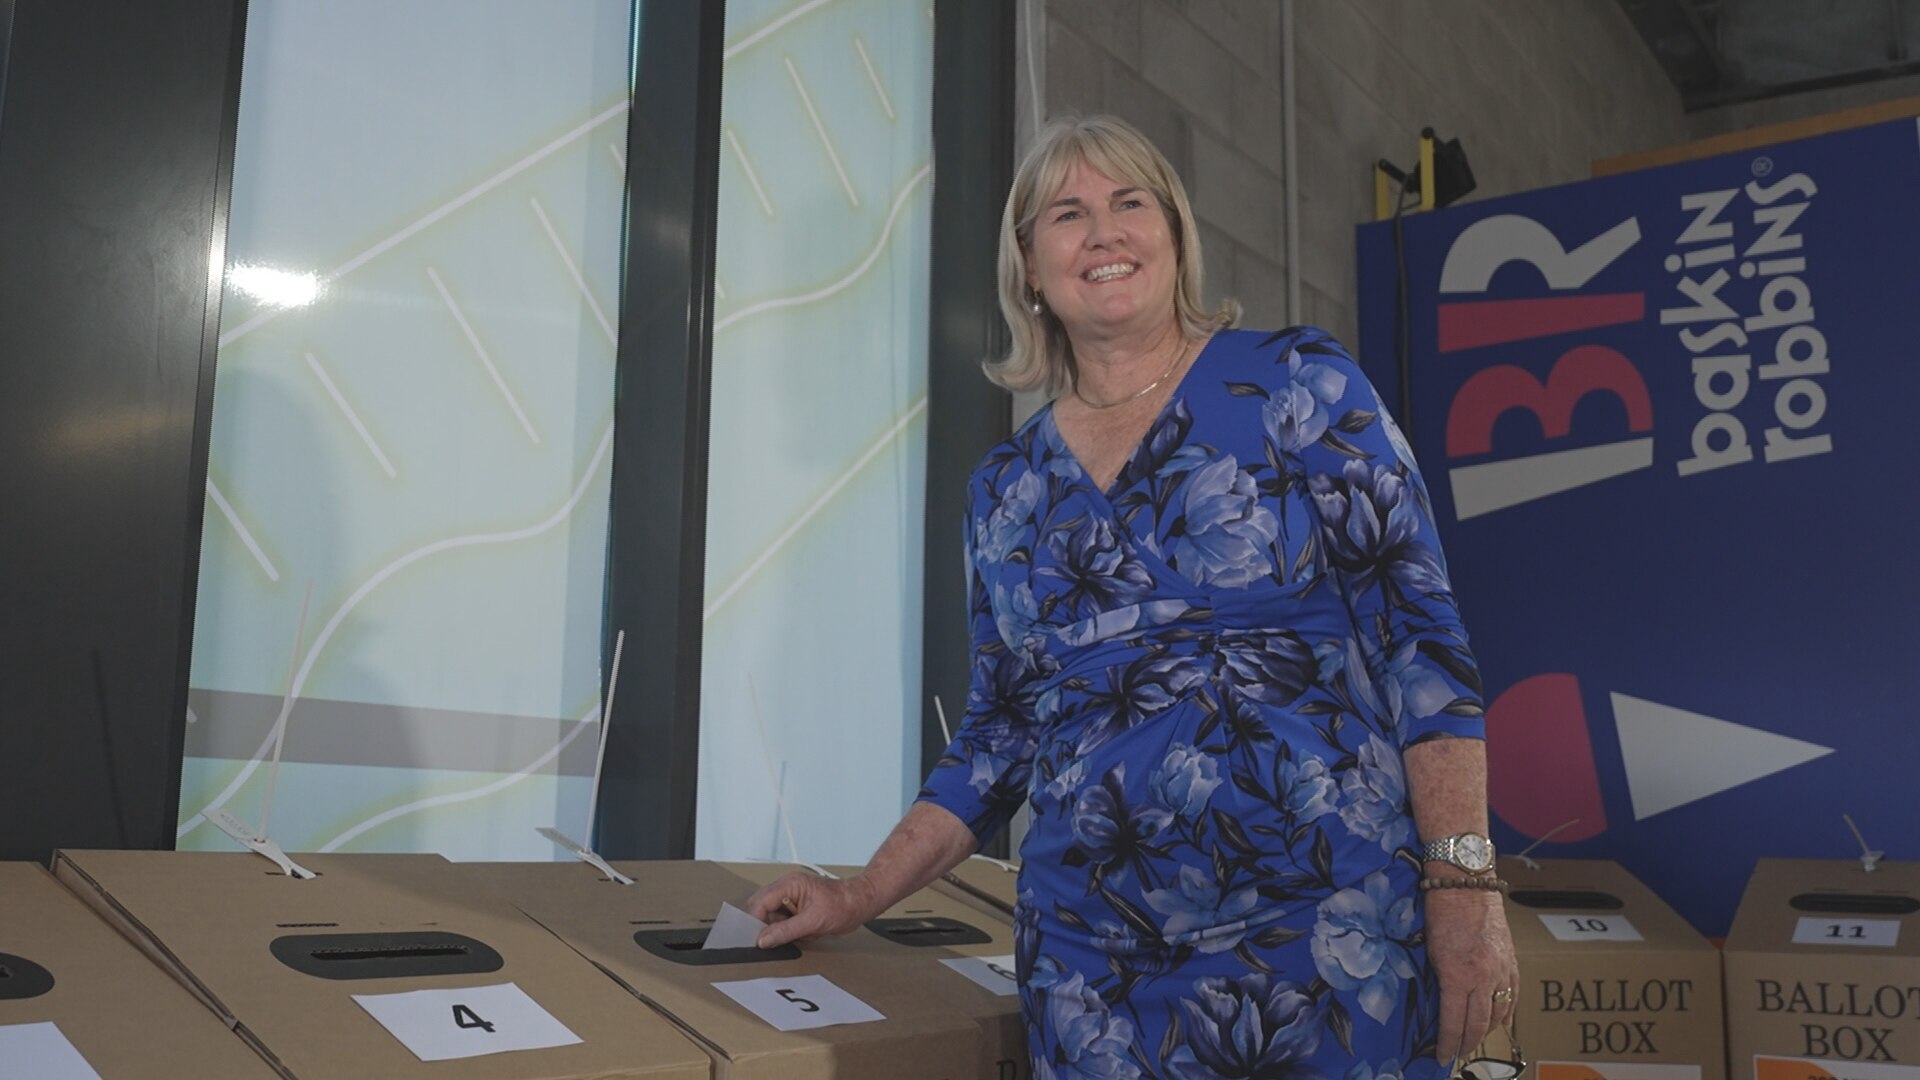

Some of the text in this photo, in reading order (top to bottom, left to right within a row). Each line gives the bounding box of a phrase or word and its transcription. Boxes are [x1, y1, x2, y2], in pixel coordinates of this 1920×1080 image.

[1567, 918, 1608, 934] 10
[1825, 924, 1867, 939] 11
[775, 988, 820, 1013] 5
[1541, 979, 1692, 1012] BALLOT
[452, 1004, 496, 1033] 4
[1579, 1021, 1659, 1054] BOX
[1800, 1024, 1897, 1061] BOX
